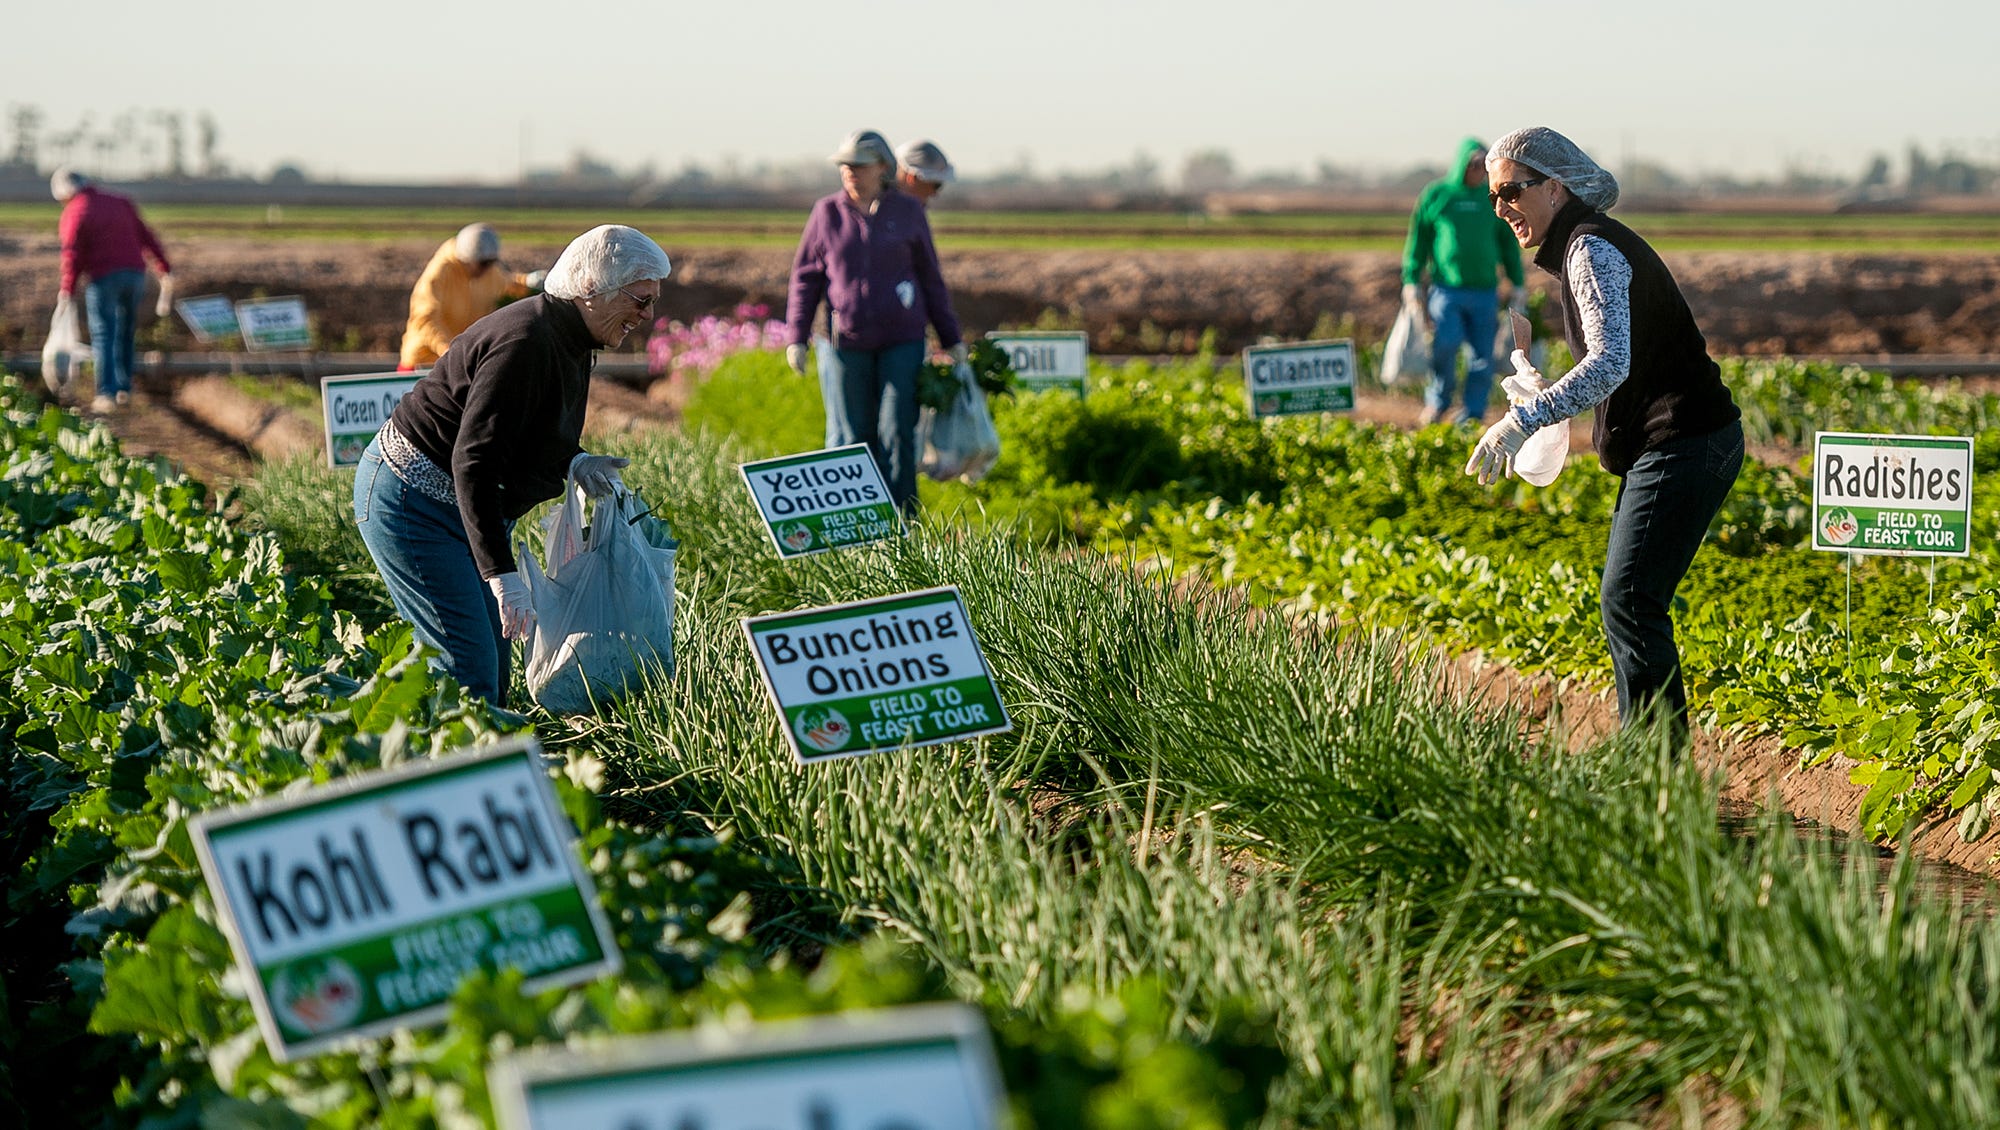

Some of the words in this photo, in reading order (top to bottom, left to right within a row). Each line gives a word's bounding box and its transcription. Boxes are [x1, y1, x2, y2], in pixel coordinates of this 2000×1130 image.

[1014, 345, 1056, 371] Dill
[1253, 356, 1346, 384] Cilantro
[333, 394, 377, 425] Green
[761, 463, 863, 493] Yellow
[1824, 454, 1961, 501] Radishes
[771, 484, 879, 515] Onions
[822, 511, 857, 530] FIELD
[858, 508, 878, 522] TO
[1877, 511, 1917, 528] FIELD
[1922, 513, 1943, 529] TO
[1864, 527, 1910, 545] FEAST
[1915, 529, 1955, 547] TOUR
[765, 611, 958, 665] Bunching
[806, 653, 950, 695] Onions
[869, 692, 926, 719] FIELD
[931, 686, 962, 705] TO
[859, 715, 923, 742] FEAST
[929, 703, 989, 730] TOUR
[235, 825, 393, 943] Kohl
[402, 783, 557, 900] Rabi
